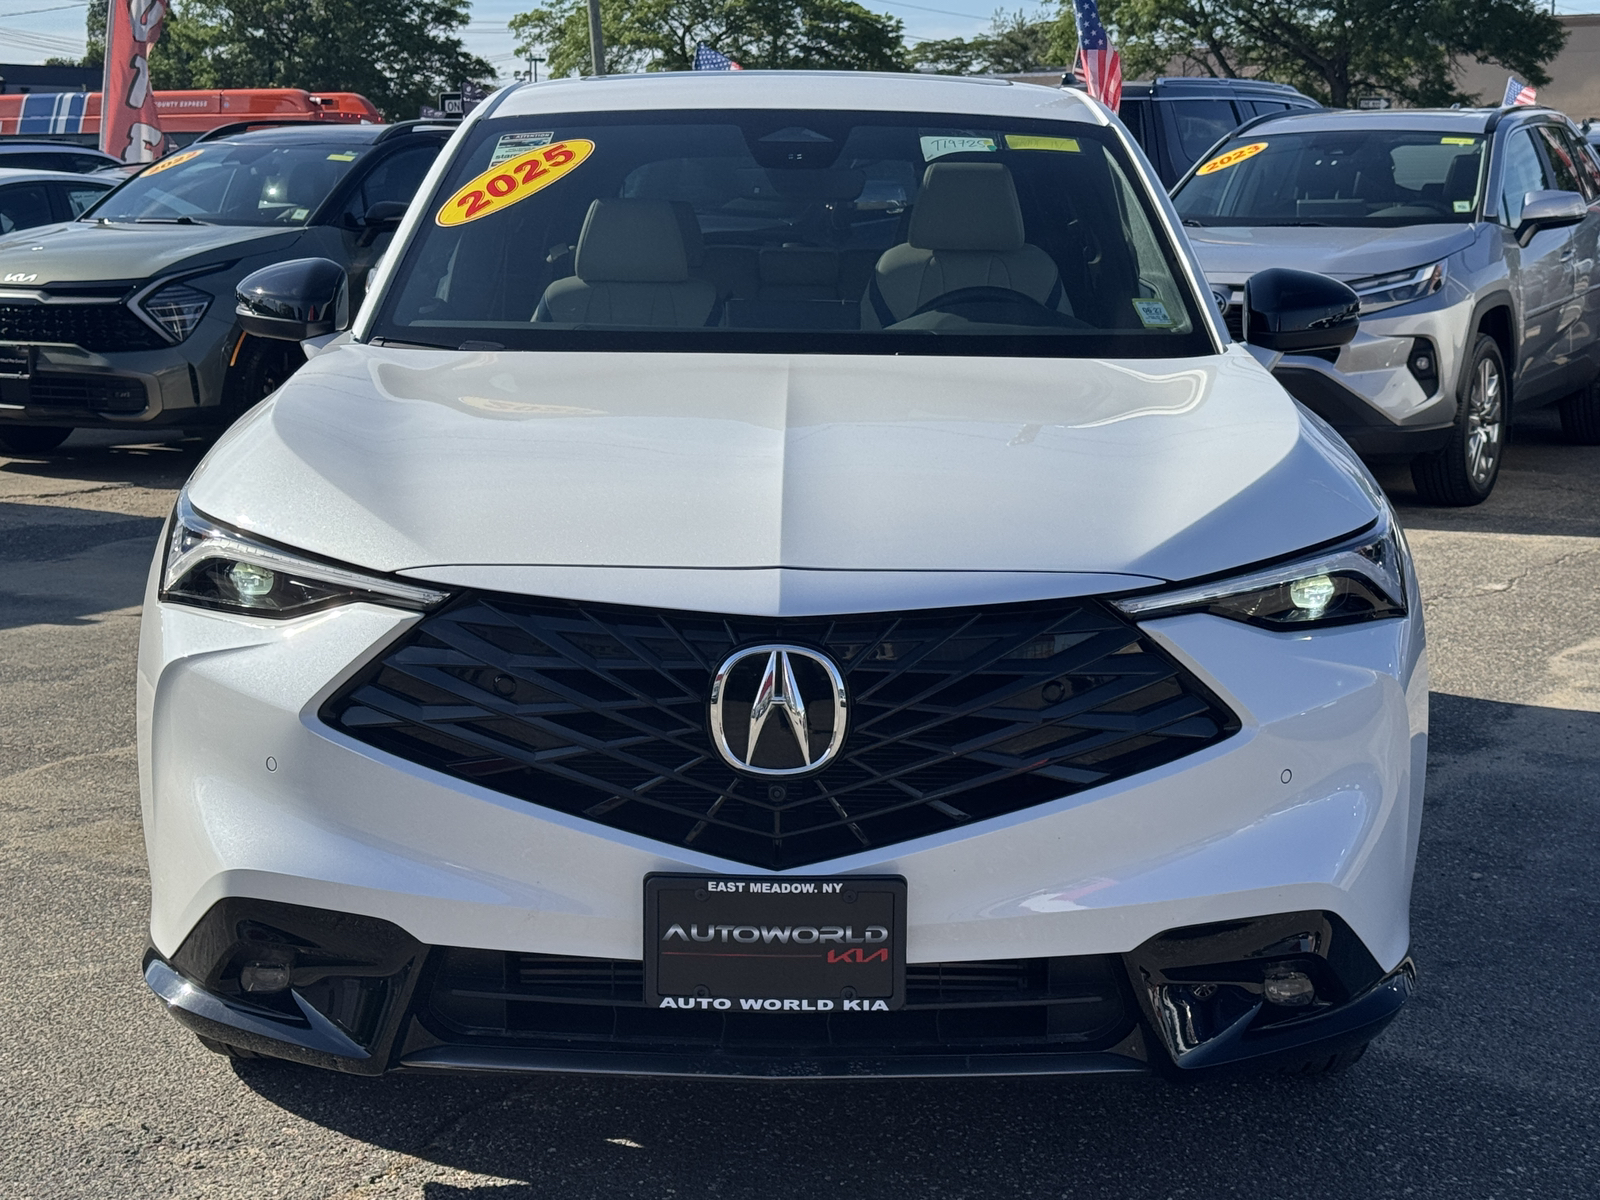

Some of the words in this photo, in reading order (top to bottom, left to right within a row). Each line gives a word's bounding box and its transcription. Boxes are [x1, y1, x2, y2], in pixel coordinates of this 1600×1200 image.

[447, 101, 460, 112] ON
[1206, 145, 1261, 173] 2023
[457, 143, 576, 219] 2025
[707, 881, 746, 893] EAST
[822, 883, 844, 894] NY
[661, 923, 889, 944] AUTOWORLD
[827, 948, 889, 963] KIA
[659, 997, 732, 1010] AUTO
[740, 998, 834, 1011] WORLD
[843, 999, 890, 1012] KIA
